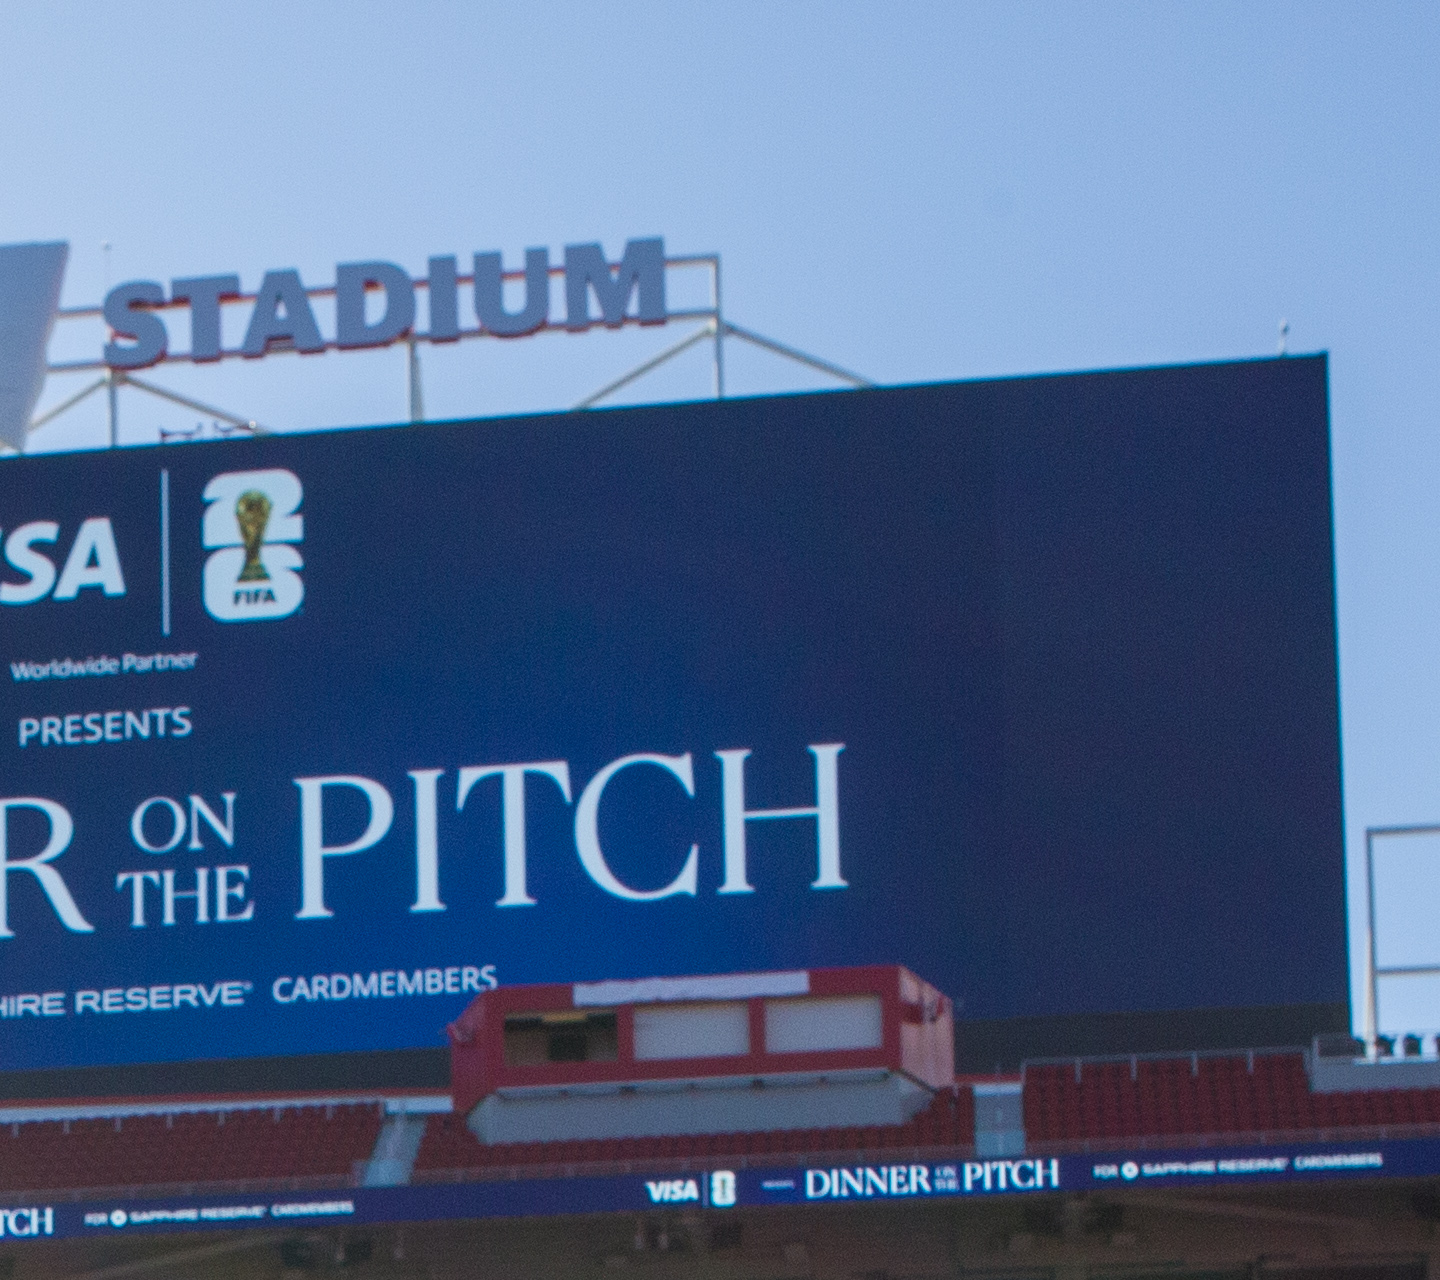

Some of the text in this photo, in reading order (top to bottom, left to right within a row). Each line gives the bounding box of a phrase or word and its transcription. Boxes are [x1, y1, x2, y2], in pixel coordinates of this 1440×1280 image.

[101, 236, 667, 371] STADIUM
[233, 588, 276, 605] FIFA
[11, 649, 198, 682] Worldwide Partner
[18, 706, 192, 748] PRESENTS
[130, 792, 237, 853] ON
[292, 742, 849, 920] PITCH
[115, 864, 255, 928] THE
[272, 965, 498, 1004] CARDMEMBERS
[645, 1179, 698, 1203] VISA
[805, 1165, 932, 1199] DINNER
[963, 1159, 1059, 1192] PITCH
